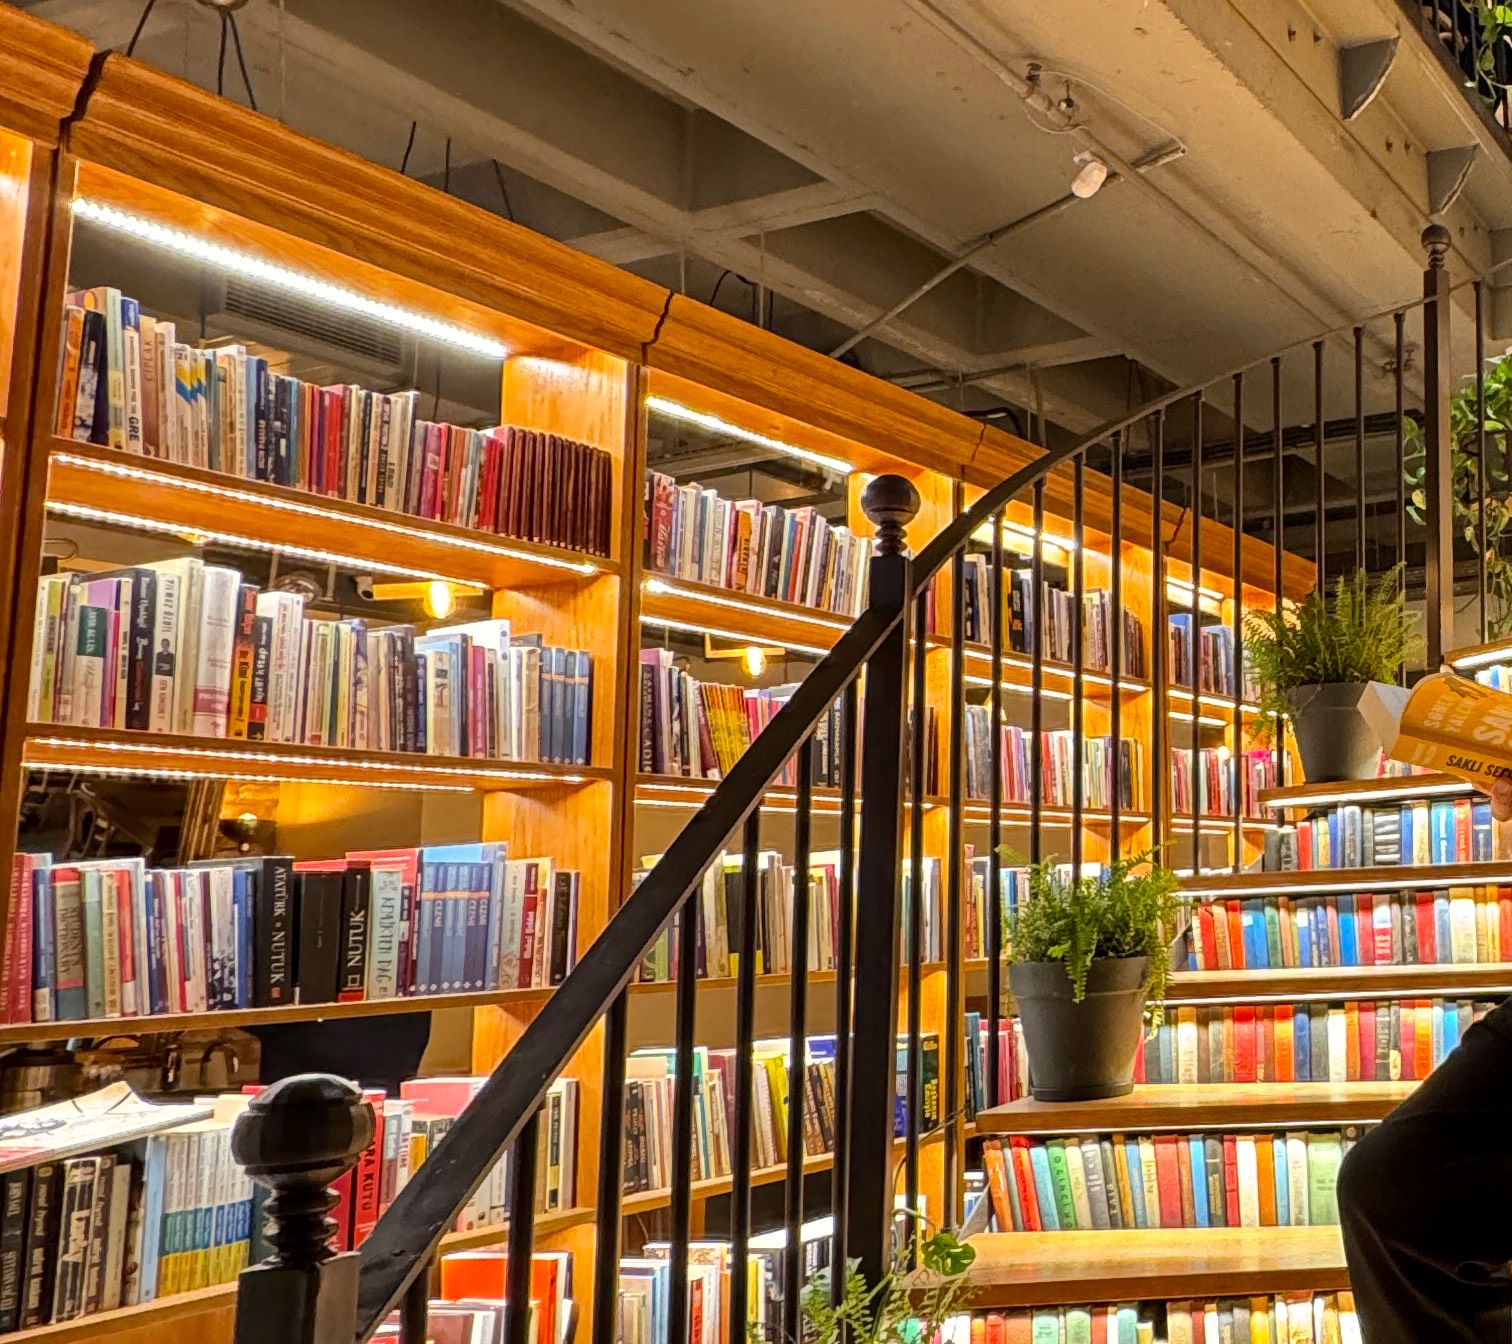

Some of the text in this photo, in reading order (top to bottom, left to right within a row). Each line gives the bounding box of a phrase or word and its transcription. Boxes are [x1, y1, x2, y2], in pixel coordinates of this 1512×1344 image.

[128, 415, 140, 442] GRE
[1446, 754, 1485, 773] SAKLI
[270, 865, 287, 984] ATATÜRK NUTUK
[347, 908, 366, 968] NUTUK
[361, 1174, 376, 1212] KUTU
